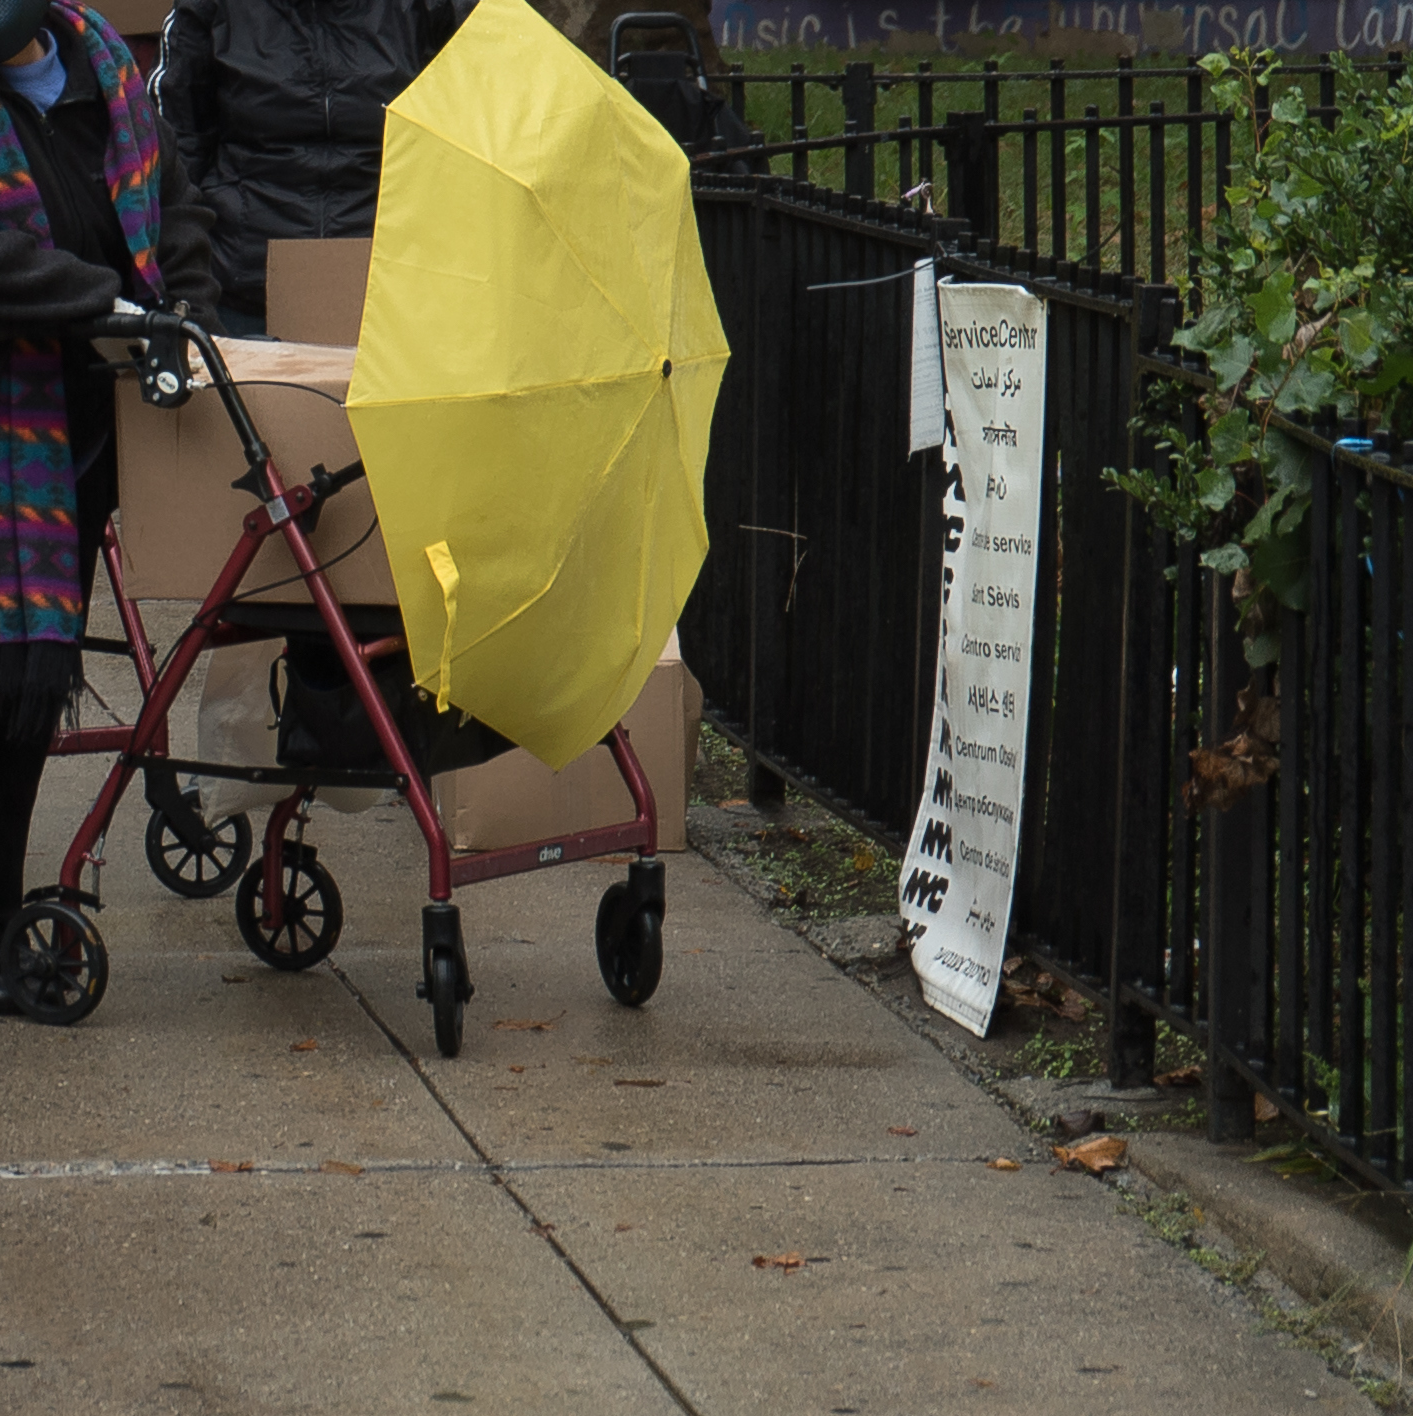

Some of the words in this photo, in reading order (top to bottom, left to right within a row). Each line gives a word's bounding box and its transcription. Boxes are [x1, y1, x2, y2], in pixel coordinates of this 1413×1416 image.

[723, 5, 829, 52] usic
[993, 533, 1032, 556] service
[987, 585, 1020, 609] Sèvis
[968, 684, 1000, 715] 서비스
[955, 735, 997, 763] Centrum
[902, 867, 949, 914] NYC
